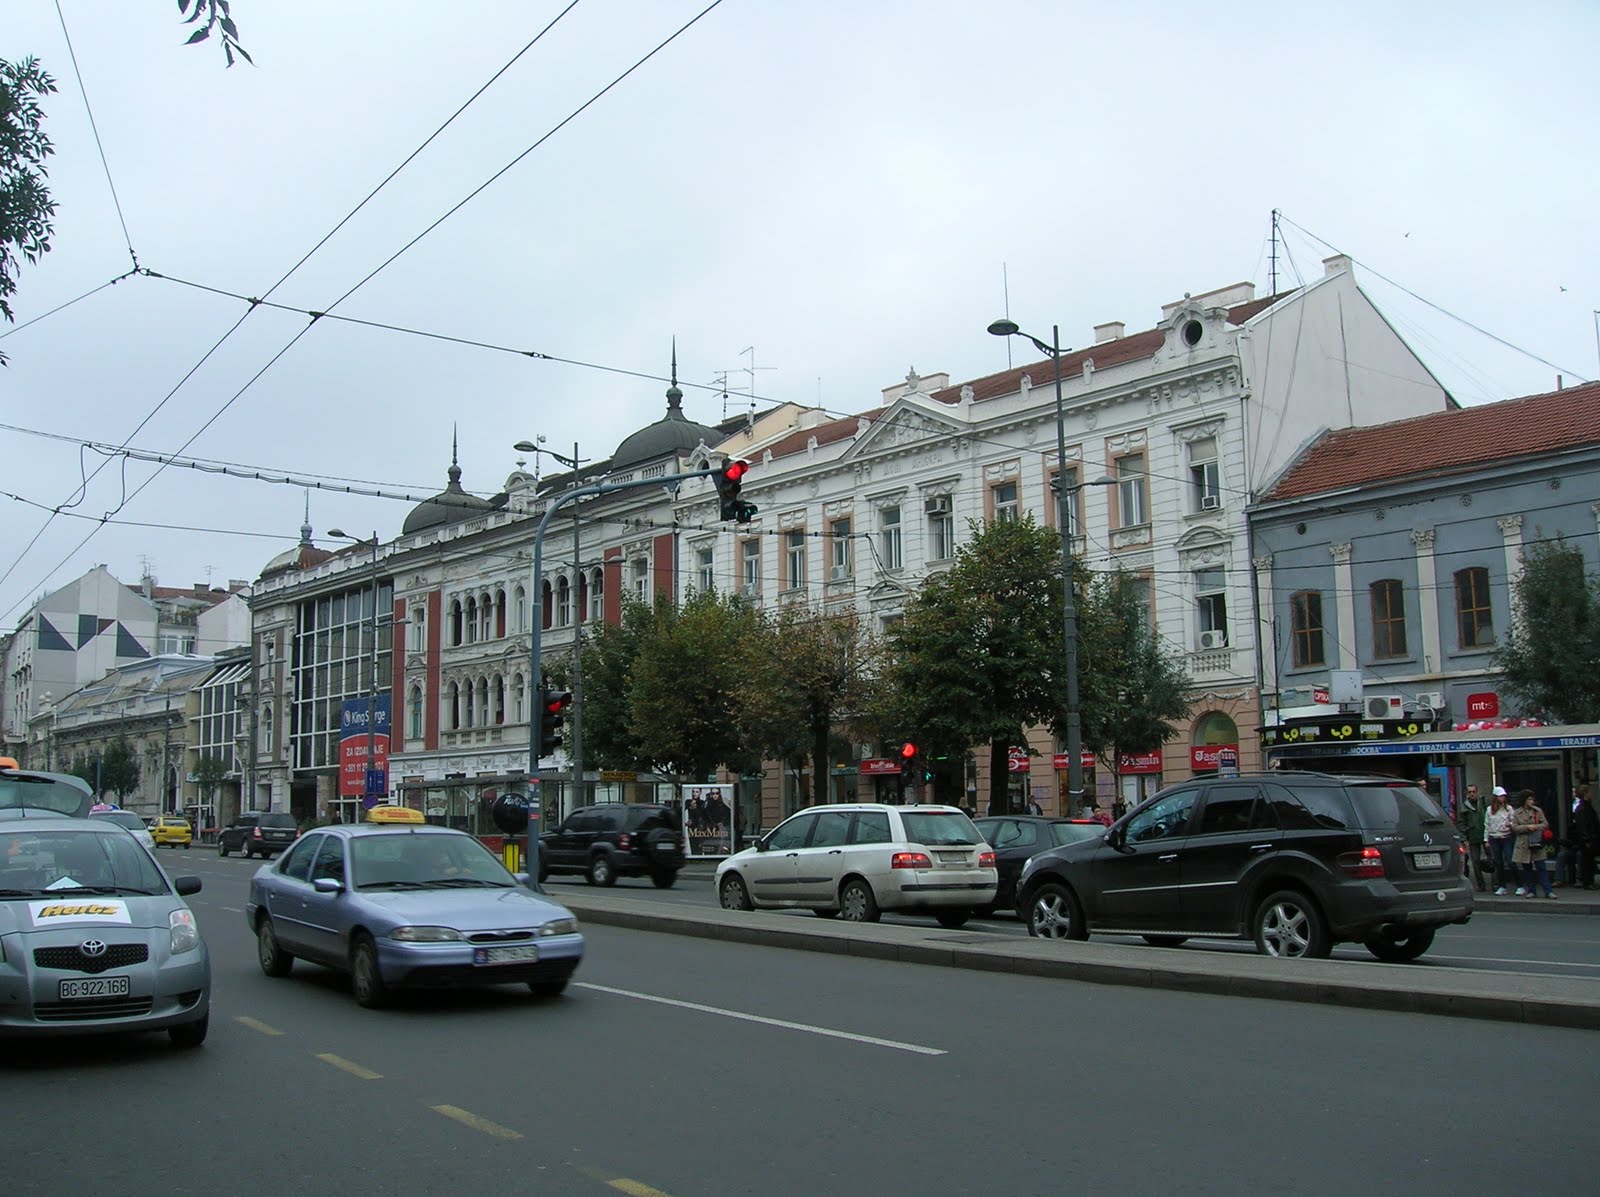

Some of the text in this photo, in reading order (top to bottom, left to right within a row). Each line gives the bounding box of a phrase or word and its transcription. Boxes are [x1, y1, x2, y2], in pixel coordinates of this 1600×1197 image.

[1560, 738, 1596, 746] TERAZIJE
[1418, 744, 1449, 752] TERAZIJE
[689, 828, 729, 838] MaxMara
[37, 904, 119, 918] Hertz
